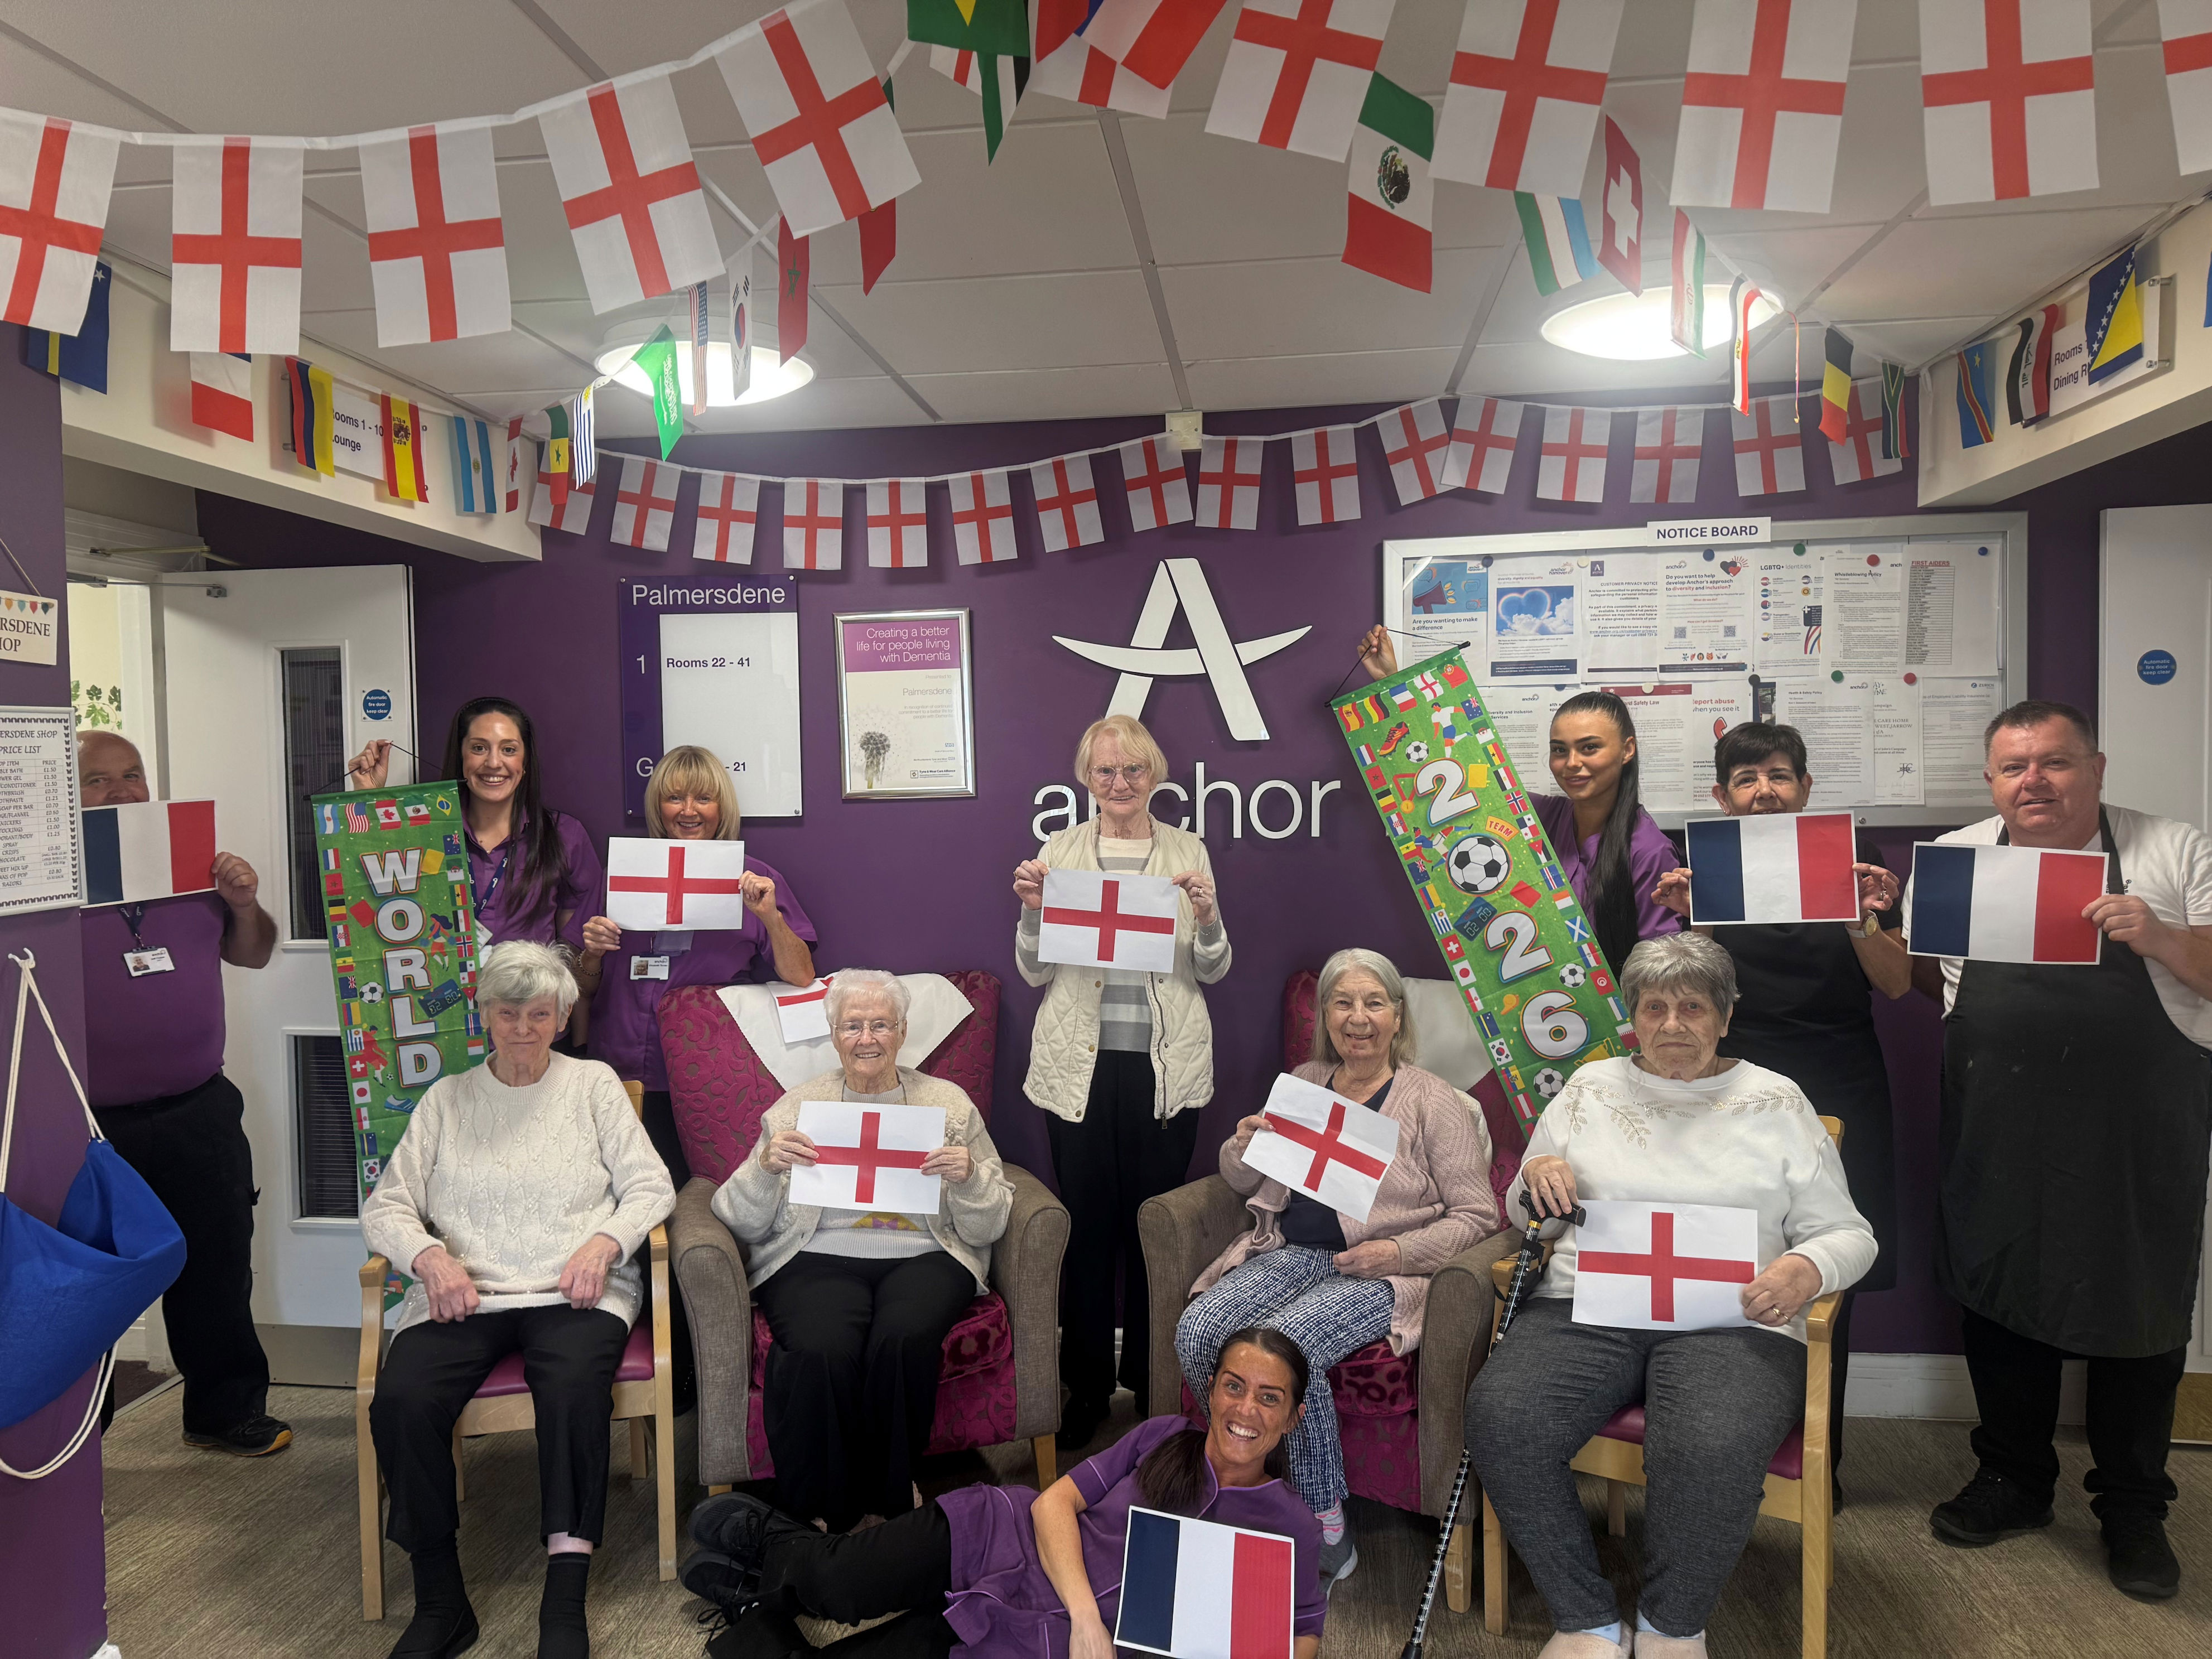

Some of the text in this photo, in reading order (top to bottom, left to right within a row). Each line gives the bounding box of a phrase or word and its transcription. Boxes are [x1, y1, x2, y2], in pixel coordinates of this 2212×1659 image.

[2055, 344, 2083, 366] Rooms
[2054, 370, 2079, 391] Dining
[361, 419, 365, 430] 1
[374, 424, 384, 437] 10
[332, 435, 361, 452] ounge
[1657, 525, 1758, 539] NOTICE BOARD
[632, 583, 785, 605] Palmersdene
[866, 628, 908, 639] Creating
[921, 626, 950, 636] better
[856, 639, 950, 652] life for people living
[637, 654, 645, 674] 1
[667, 658, 708, 668] Rooms
[712, 657, 726, 668] 22
[737, 657, 750, 667] 41
[880, 651, 951, 663] with Dementia
[37, 730, 57, 738] SHOP
[636, 757, 653, 777] G
[734, 762, 746, 771] 21
[1032, 762, 1341, 842] achor
[1489, 821, 1513, 837] TEAM
